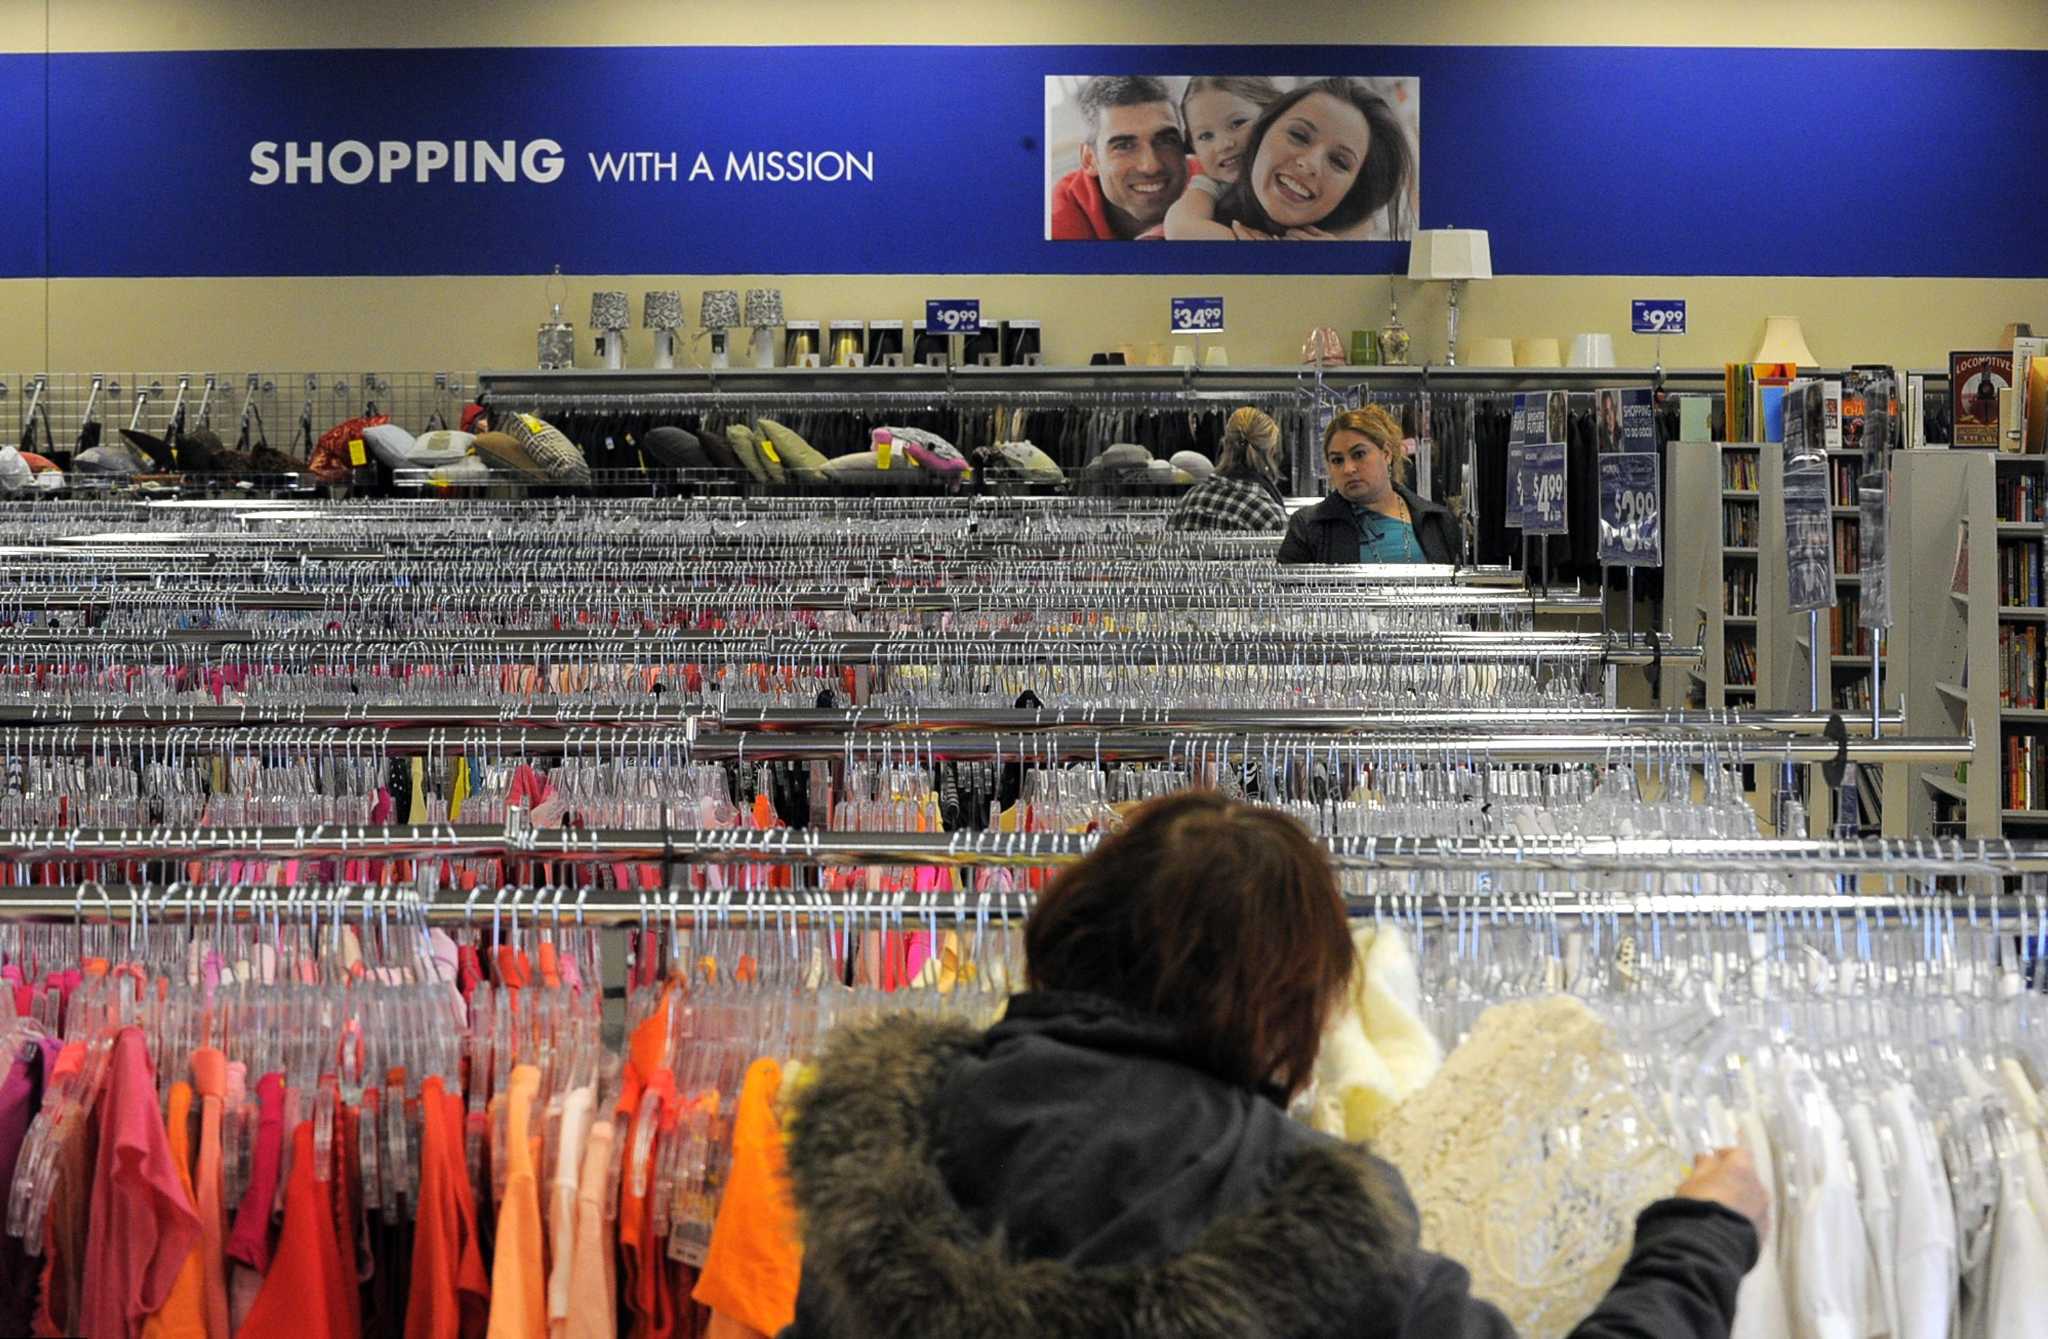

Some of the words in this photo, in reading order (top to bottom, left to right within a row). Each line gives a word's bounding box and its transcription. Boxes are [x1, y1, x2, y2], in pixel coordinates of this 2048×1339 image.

[249, 138, 565, 185] SHOPPING
[588, 151, 677, 182] WITH
[688, 151, 715, 181] A
[724, 151, 874, 182] MISSION
[1623, 405, 1651, 417] SHOPPING
